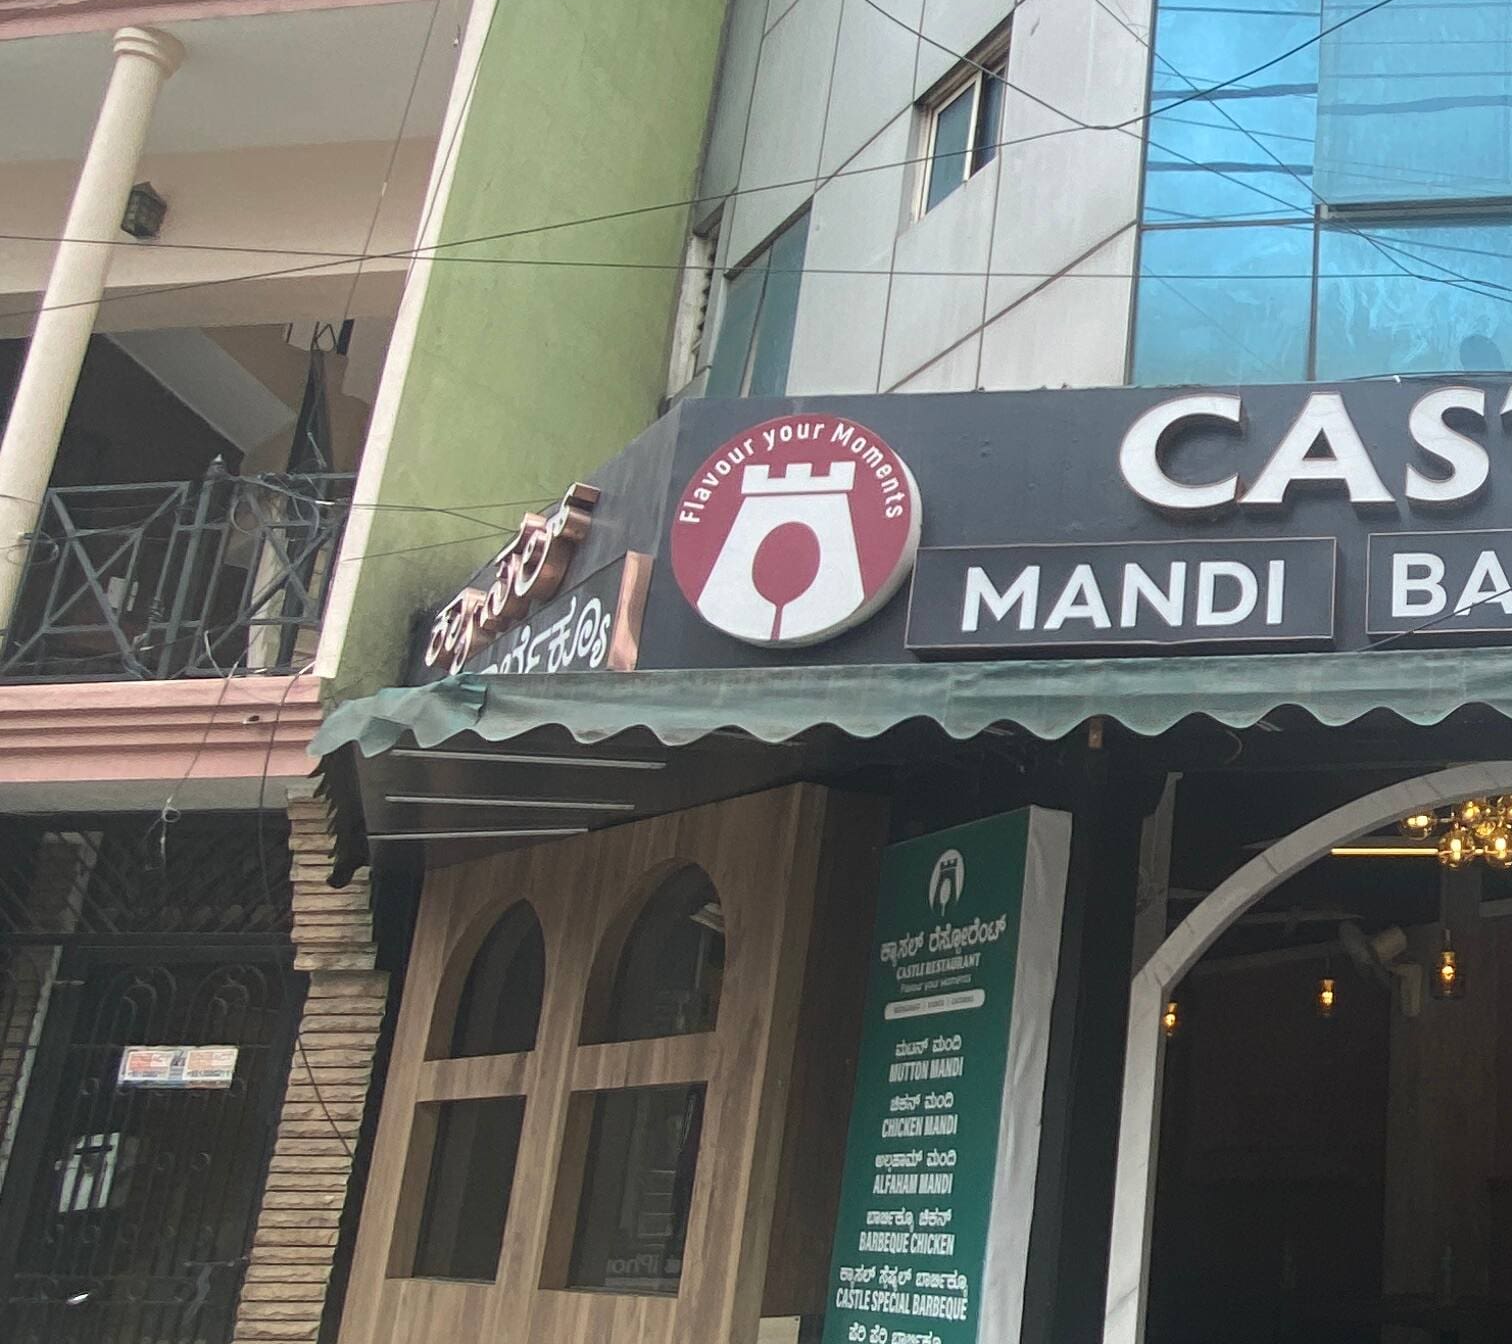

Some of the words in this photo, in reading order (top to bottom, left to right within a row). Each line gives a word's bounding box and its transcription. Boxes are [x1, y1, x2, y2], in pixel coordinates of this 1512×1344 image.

[679, 437, 755, 523] Flavour
[763, 423, 825, 451] your
[830, 422, 903, 519] Moments
[961, 558, 1285, 633] MANDI
[889, 1060, 929, 1083] MUTTON
[930, 1056, 964, 1081] MANDI
[882, 1116, 923, 1138] CHICKEN
[923, 1114, 959, 1136] MANDI
[872, 1174, 918, 1194] ALFAHAM
[918, 1173, 954, 1194] MANDI
[858, 1231, 910, 1255] BARBEQUE
[910, 1233, 955, 1256] CHICKEN
[836, 1288, 871, 1309] CASTLE
[871, 1290, 911, 1314] SPECIAL
[912, 1295, 968, 1320] BARBEQUE
